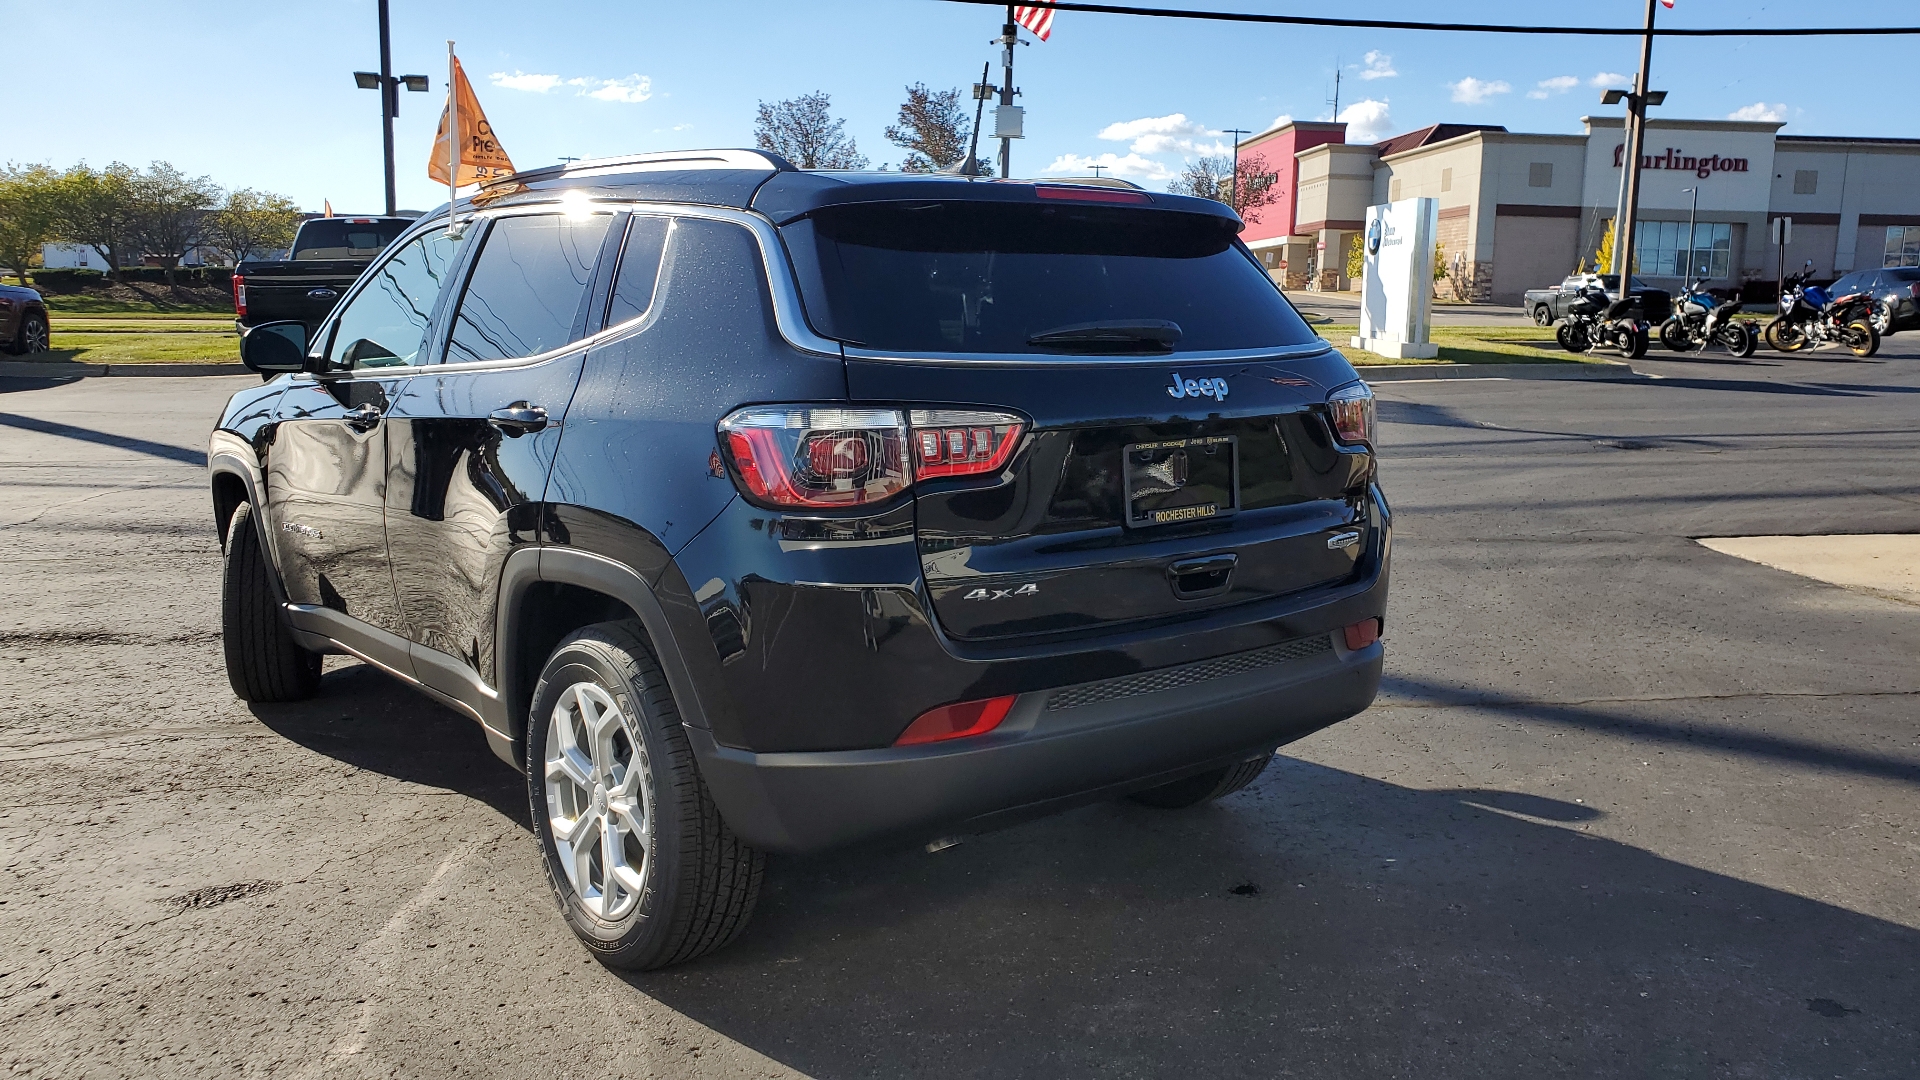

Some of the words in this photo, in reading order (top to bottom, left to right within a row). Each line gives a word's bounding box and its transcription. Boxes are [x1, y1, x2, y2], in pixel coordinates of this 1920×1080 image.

[1167, 372, 1229, 402] Jeep
[1155, 507, 1196, 523] ROCHESTER
[1197, 505, 1216, 518] HILLS
